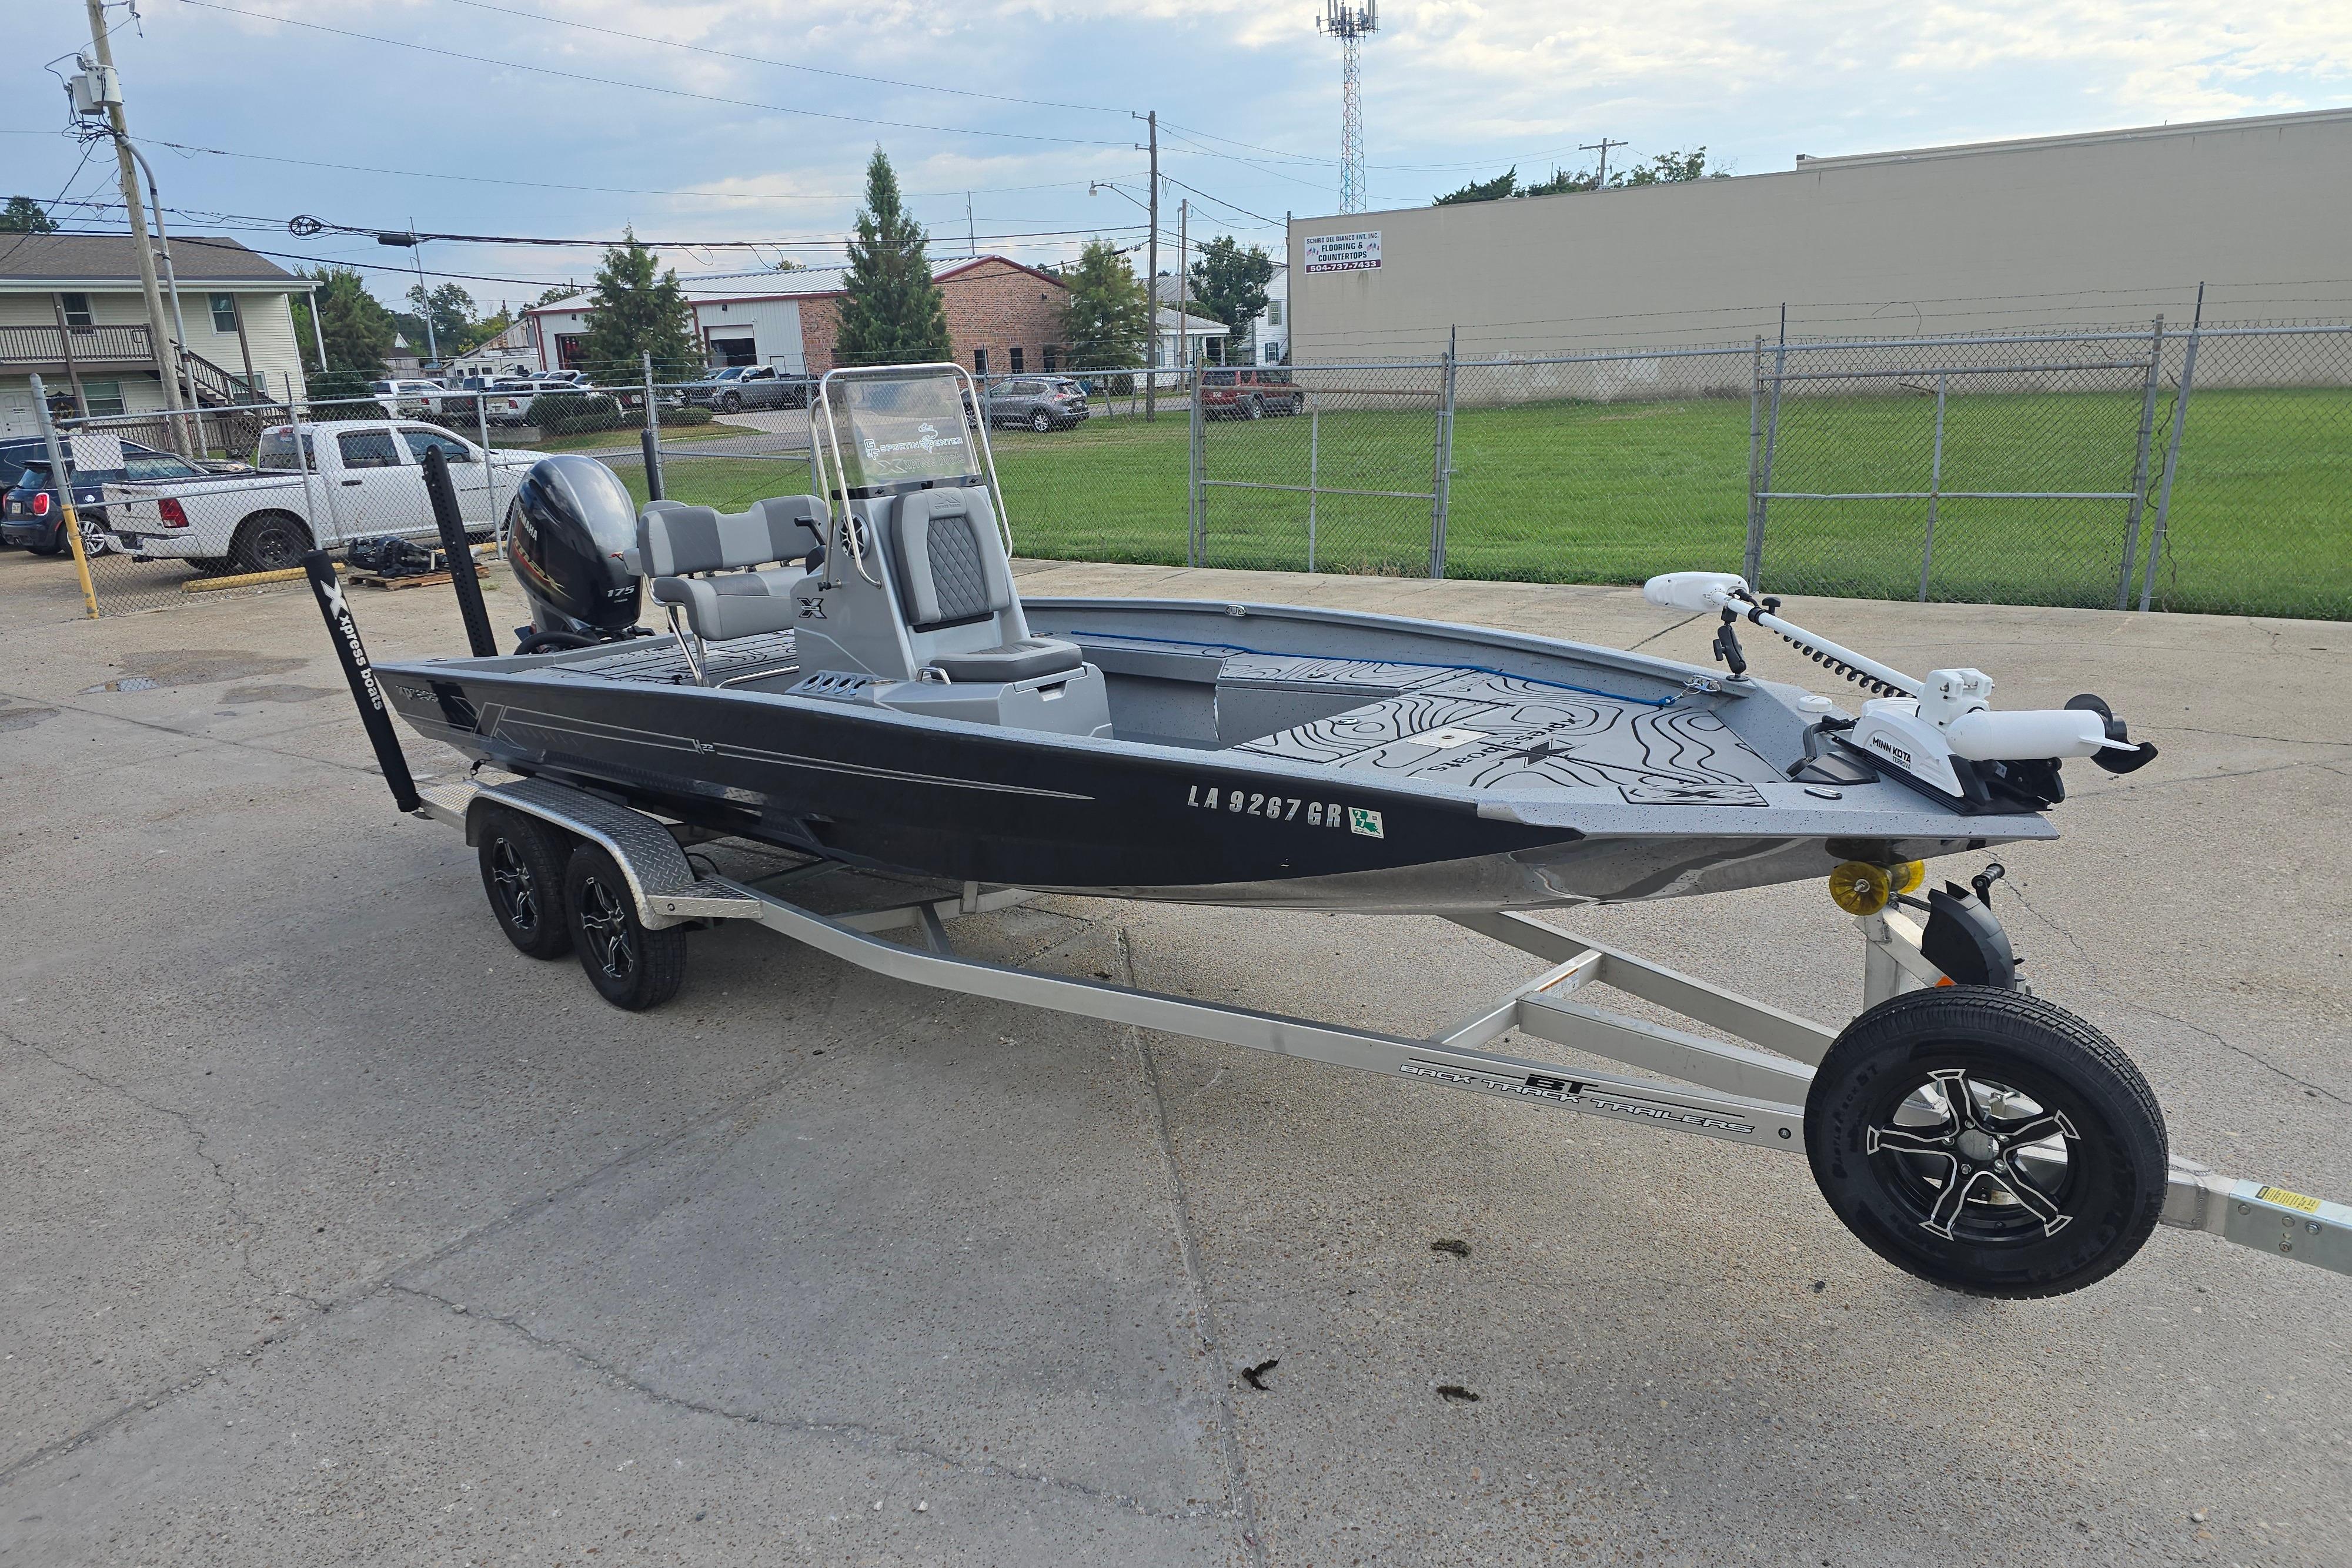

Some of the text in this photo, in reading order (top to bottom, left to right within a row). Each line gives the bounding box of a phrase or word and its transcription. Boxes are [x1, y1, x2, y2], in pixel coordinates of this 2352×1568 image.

[1318, 251, 1367, 262] COUNTERTOPS
[1321, 243, 1355, 252] FLOORING
[1310, 260, 1377, 271] 504-737-7433
[880, 440, 926, 452] SPORTING
[929, 437, 964, 446] CENTER
[939, 451, 964, 466] boats
[607, 585, 635, 597] 175
[339, 614, 366, 666] xpress
[360, 668, 383, 710] boats
[1501, 718, 1584, 745] xpress
[1427, 746, 1509, 772] boats
[1872, 737, 1911, 763] MINN KOTA
[1188, 785, 1342, 827] LA 9267 GR
[1399, 1064, 1756, 1134] BACK TRACK TRAILERS
